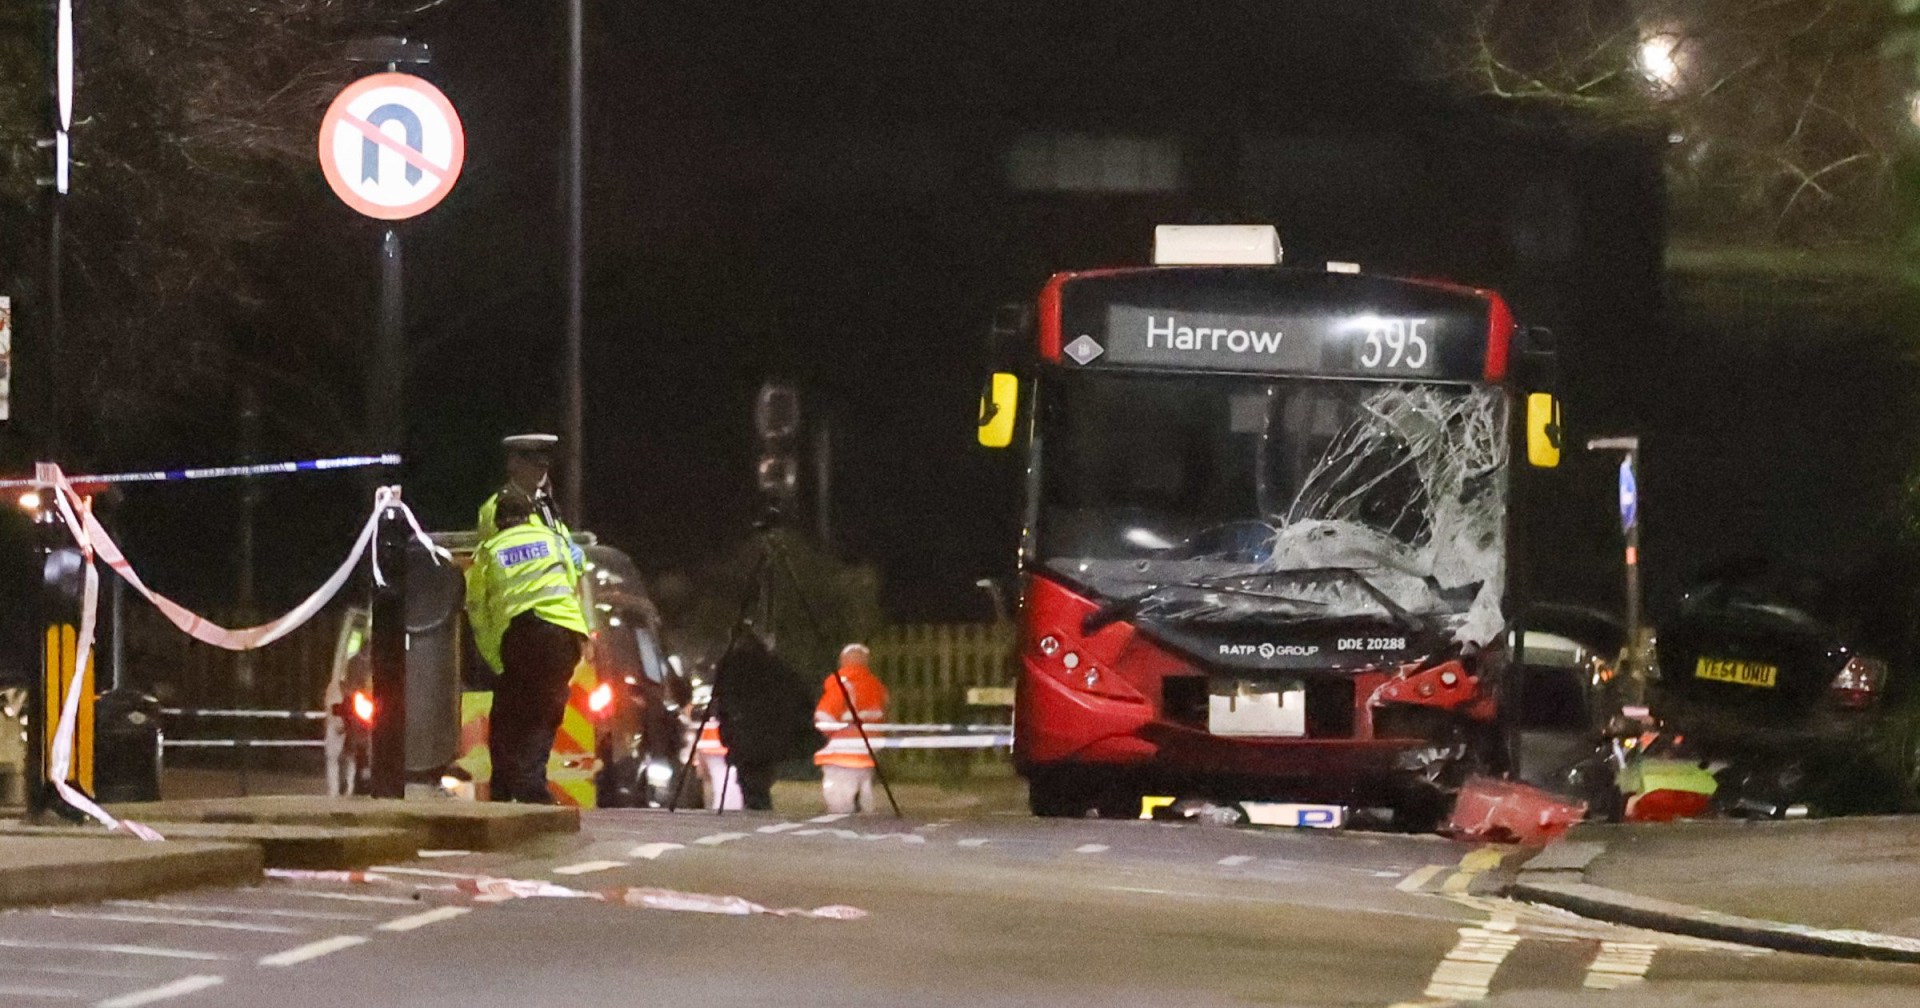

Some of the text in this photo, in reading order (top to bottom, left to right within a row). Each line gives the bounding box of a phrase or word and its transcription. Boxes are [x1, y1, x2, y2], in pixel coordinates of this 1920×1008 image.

[1146, 316, 1427, 369] Harrow 395
[498, 544, 549, 567] POLICE
[1219, 645, 1319, 656] RATP GROUP
[1337, 638, 1406, 650] DDE 20288
